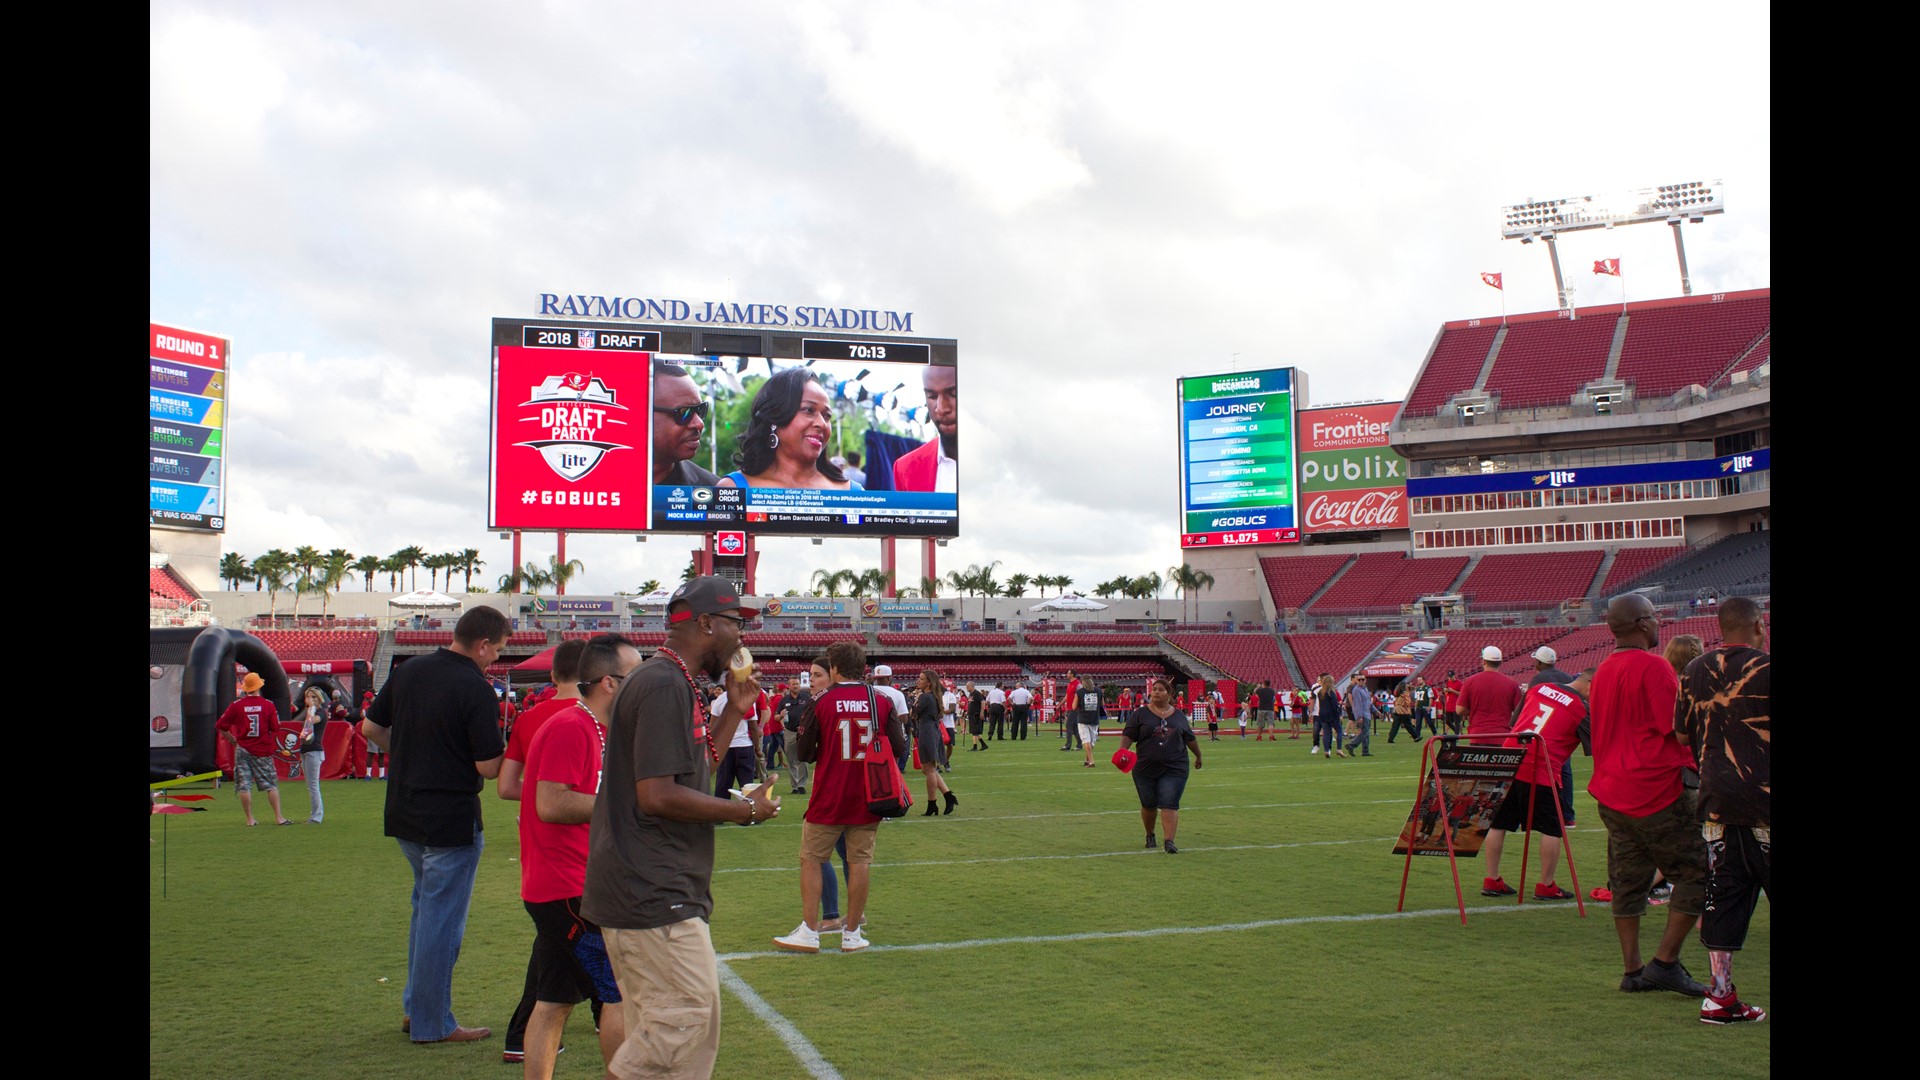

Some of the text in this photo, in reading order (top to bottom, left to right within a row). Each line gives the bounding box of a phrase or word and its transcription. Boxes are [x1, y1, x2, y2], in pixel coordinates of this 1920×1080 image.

[540, 294, 914, 332] RAYMOND JAMES STADIUM
[156, 334, 218, 359] ROUND 1
[538, 332, 646, 348] 2018 NFL DRAFT
[849, 346, 886, 358] 70:13
[152, 365, 188, 377] BALTIMORE
[152, 372, 188, 386] RAVENS
[1212, 378, 1260, 393] BUCCANEERS
[160, 397, 189, 407] ANGELES
[1206, 402, 1266, 416] JOURNEY
[150, 402, 193, 417] HARGERS
[542, 408, 606, 429] DRAFT
[154, 426, 181, 436] SEATTLE
[552, 427, 596, 441] PARTY
[1313, 420, 1390, 440] Frontier
[150, 432, 193, 446] AHAWKS
[1313, 436, 1386, 448] COMMUNICATIONS
[1221, 447, 1251, 455] WYOMING
[154, 457, 178, 466] DALLAS
[562, 454, 587, 469] Lite
[1733, 456, 1752, 472] Lite
[150, 463, 190, 476] OWBOYS
[1302, 455, 1399, 483] Publix
[1550, 472, 1576, 487] Lite
[151, 487, 178, 495] DETROIT
[521, 490, 620, 506] #GOBUCS
[150, 494, 178, 504] LIONS
[1305, 490, 1404, 528] Coca-Cola
[180, 513, 202, 521] GOING
[1212, 516, 1266, 527] #GOBUCS
[1223, 532, 1258, 544] $1,075
[312, 663, 331, 672] BUCS
[1538, 685, 1574, 706] WINSTON
[836, 700, 868, 712] EVANS
[1522, 702, 1555, 734] 3
[247, 714, 259, 737] 3
[836, 718, 872, 761] 13
[1462, 753, 1521, 764] TEAM STORE
